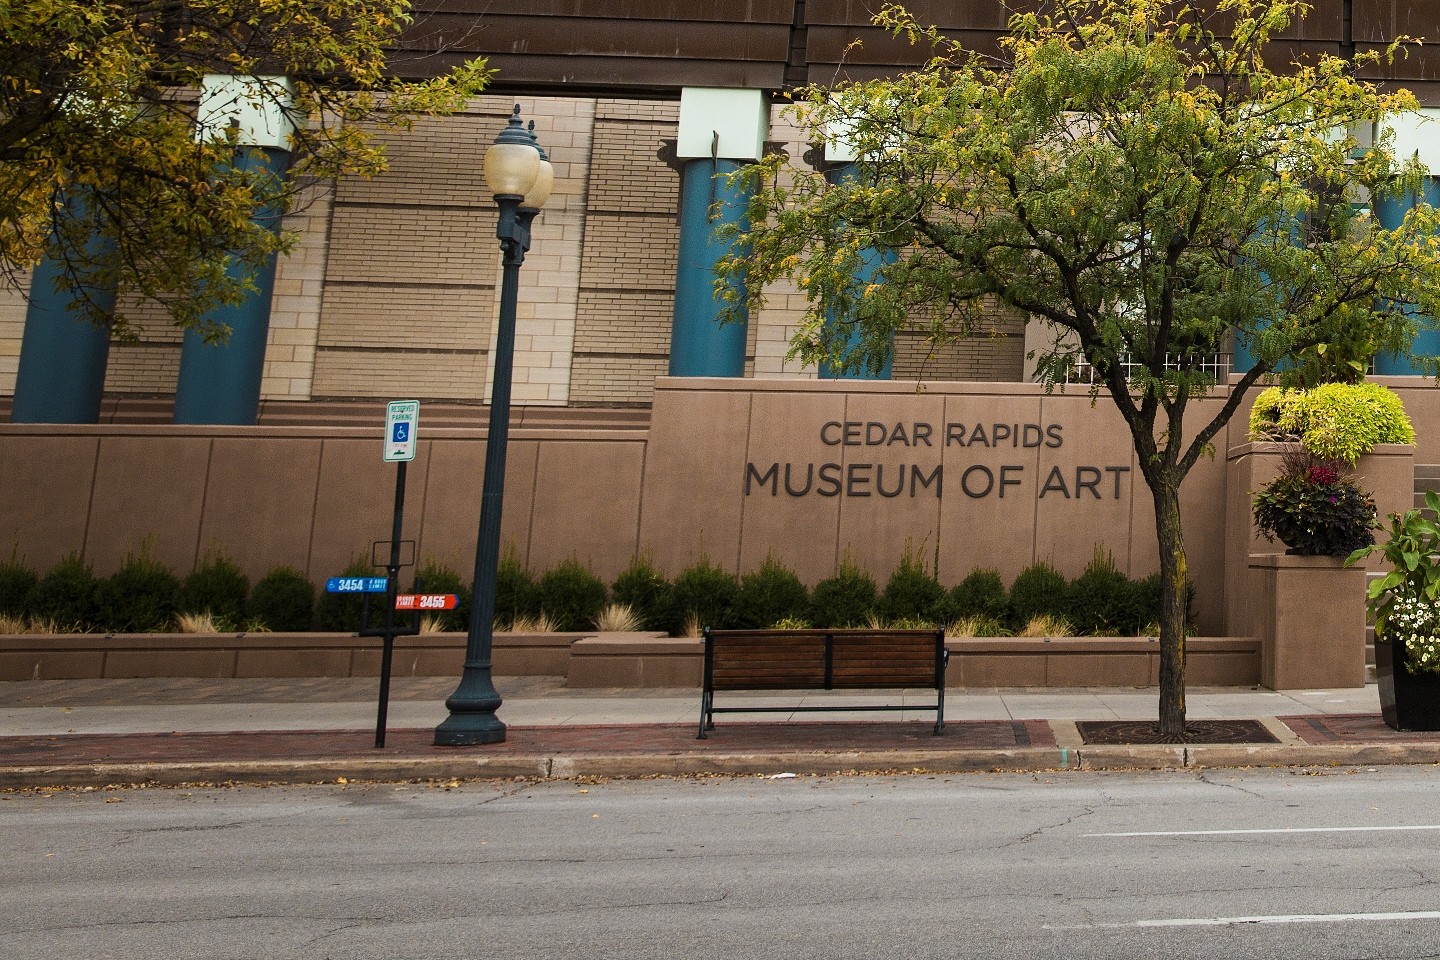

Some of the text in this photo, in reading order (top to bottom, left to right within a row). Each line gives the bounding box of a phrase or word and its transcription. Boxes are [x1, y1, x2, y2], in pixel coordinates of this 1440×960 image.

[820, 421, 1064, 449] CEDAR RAPIDS
[744, 462, 1131, 500] MUSEUM OF ART
[338, 579, 363, 591] 3454
[419, 596, 445, 608] 3455
